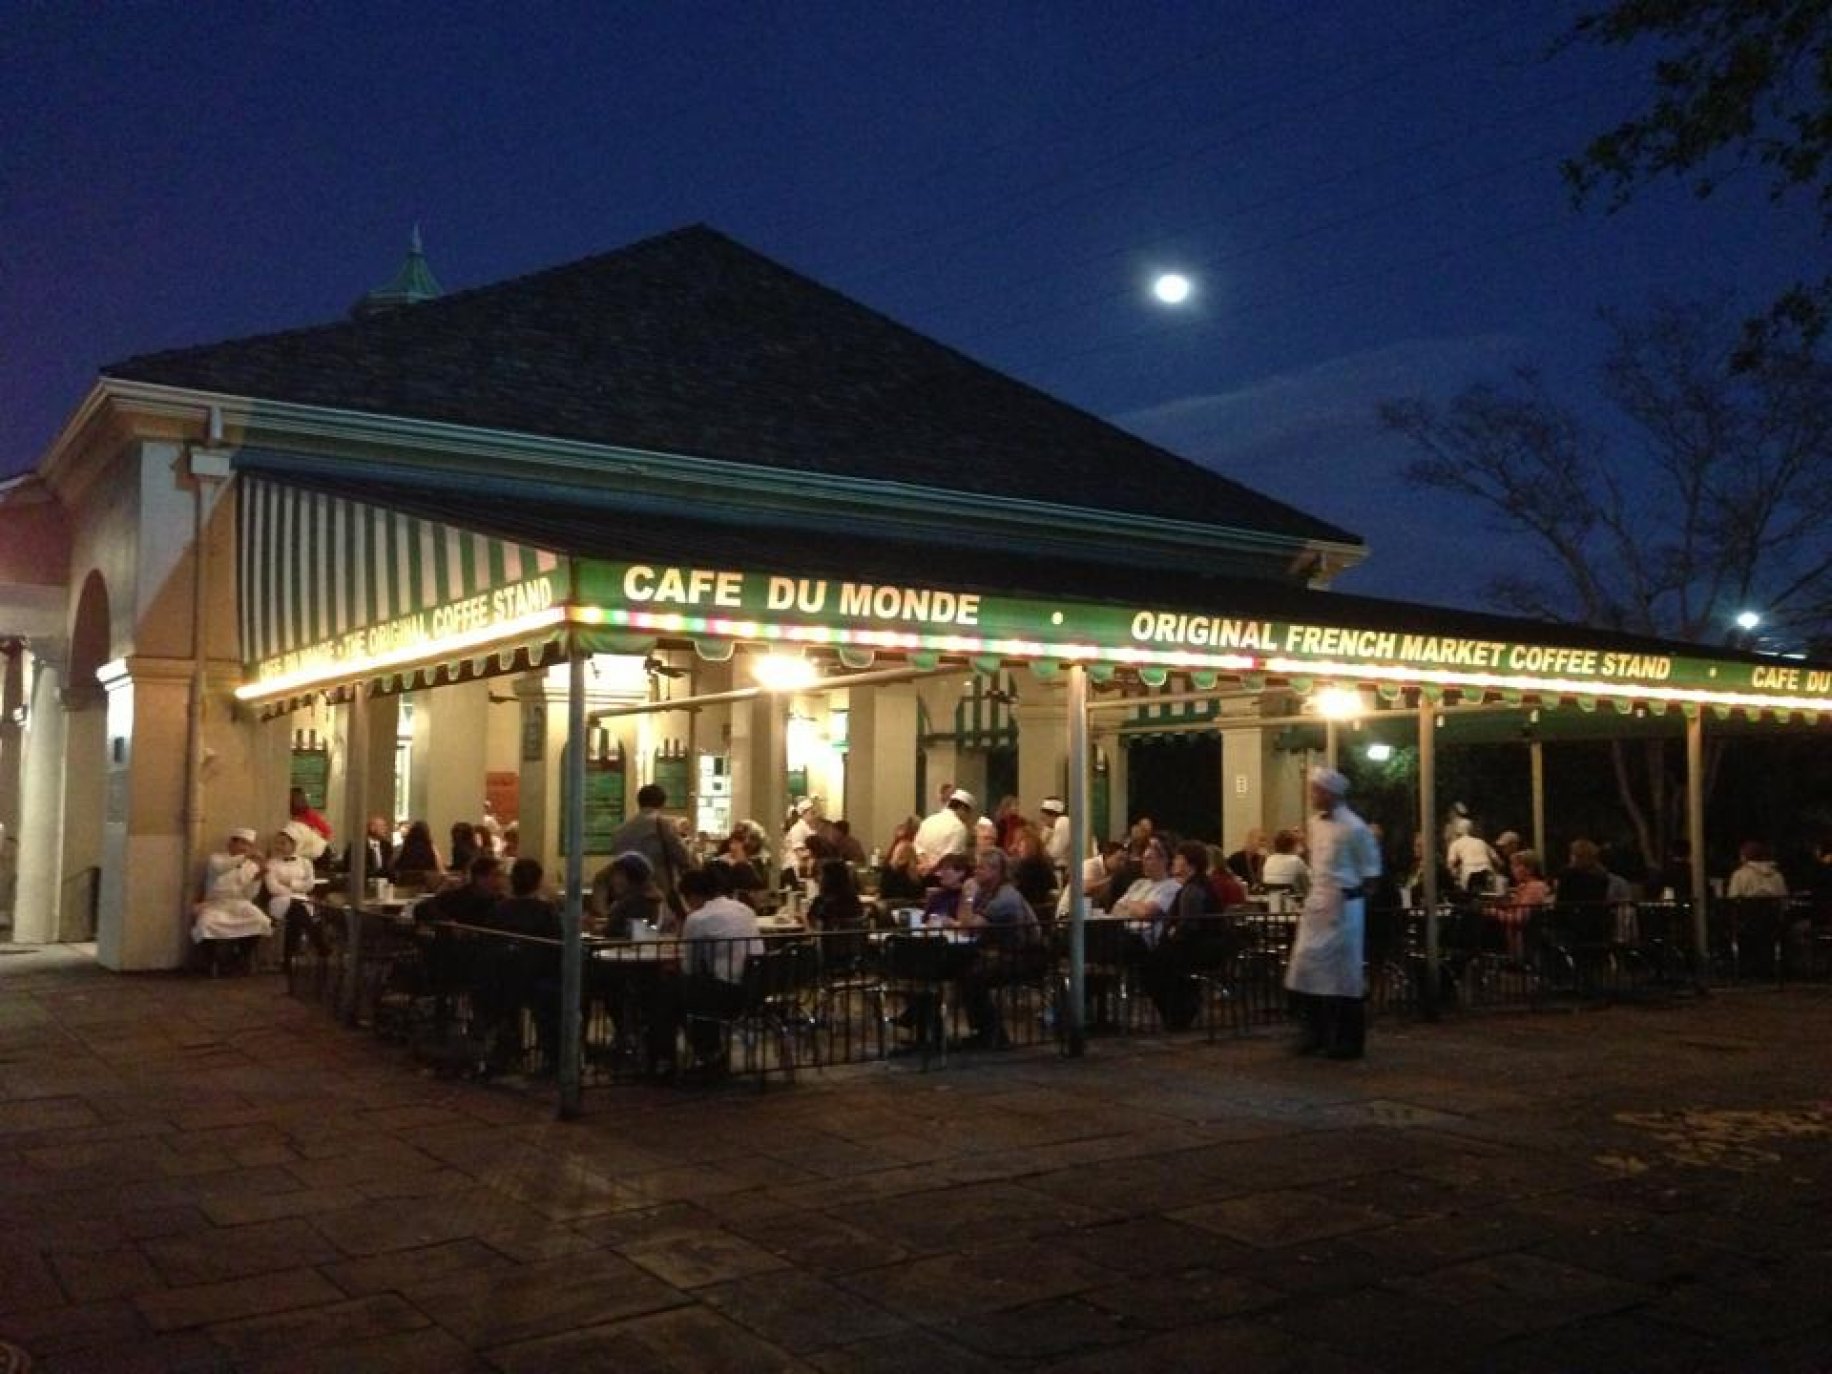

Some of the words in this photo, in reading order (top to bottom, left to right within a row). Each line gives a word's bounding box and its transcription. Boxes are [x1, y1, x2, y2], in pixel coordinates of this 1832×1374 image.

[432, 594, 489, 640] COFFEE
[492, 576, 553, 625] STAND
[623, 565, 744, 608] CAFE
[768, 576, 826, 613] DU
[839, 583, 981, 625] MONDE
[1131, 611, 1278, 651] ORIGINAL
[1286, 625, 1397, 659] FRENCH
[1400, 635, 1506, 667] MARKET
[1509, 644, 1598, 675] COFFEE
[1601, 652, 1671, 680] STAND
[1753, 666, 1800, 690] CAFE
[1805, 671, 1831, 693] DU
